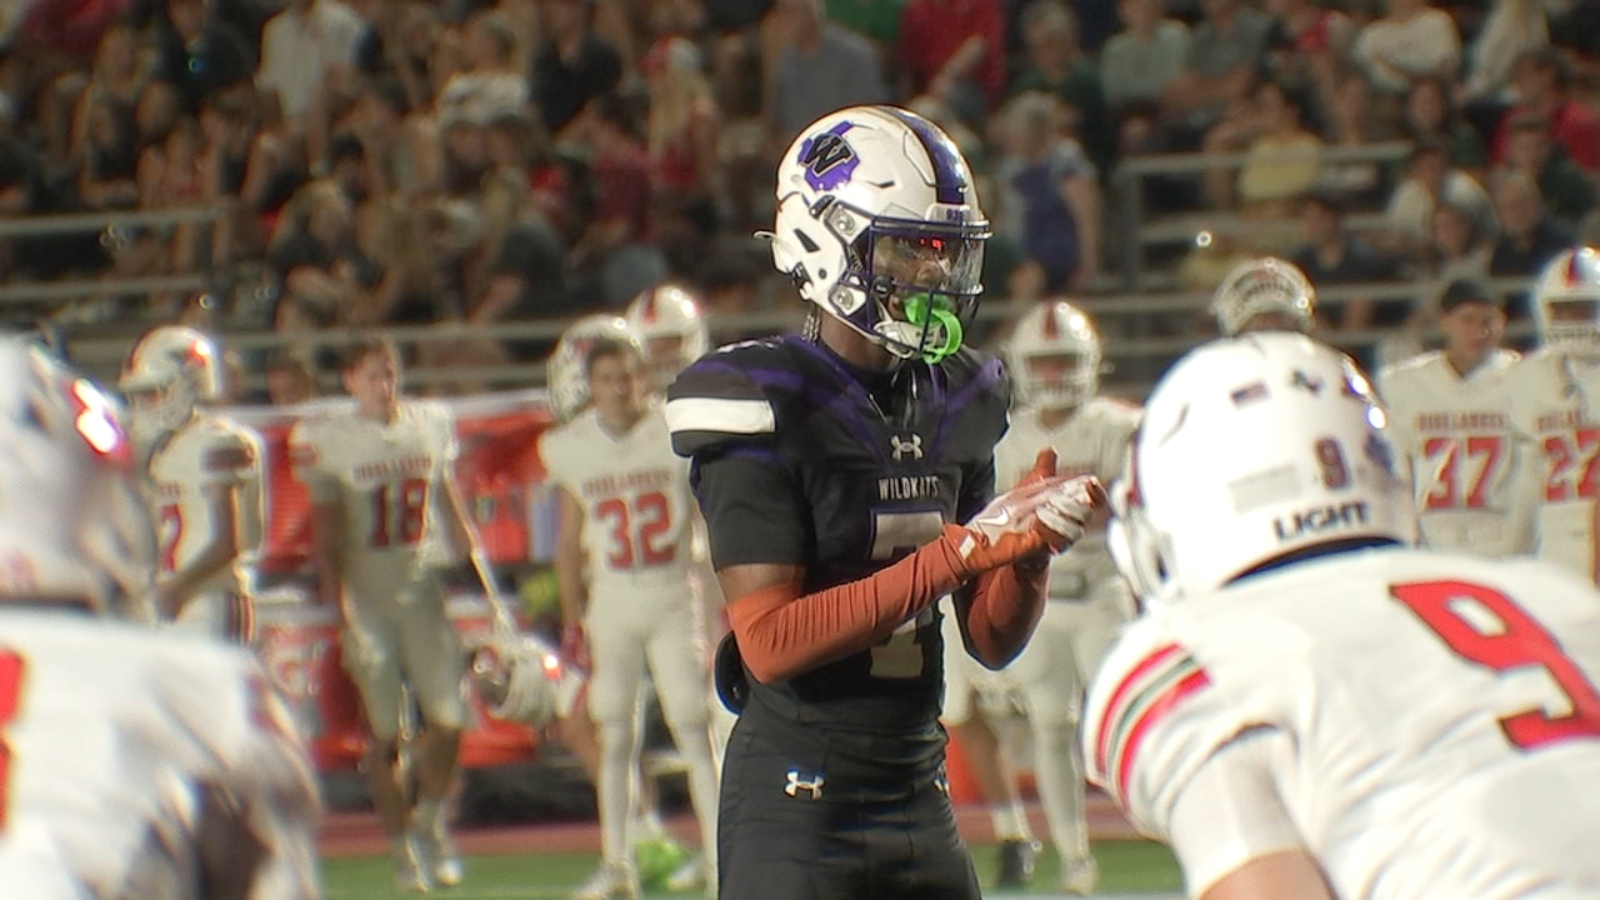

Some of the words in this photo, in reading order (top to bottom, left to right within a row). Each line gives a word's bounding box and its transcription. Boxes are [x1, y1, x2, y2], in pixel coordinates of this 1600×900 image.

[801, 133, 854, 177] W
[1422, 437, 1505, 509] 37
[371, 478, 427, 549] 18
[596, 490, 677, 570] 32
[1272, 501, 1370, 540] LIGHT
[1388, 579, 1600, 752] 9
